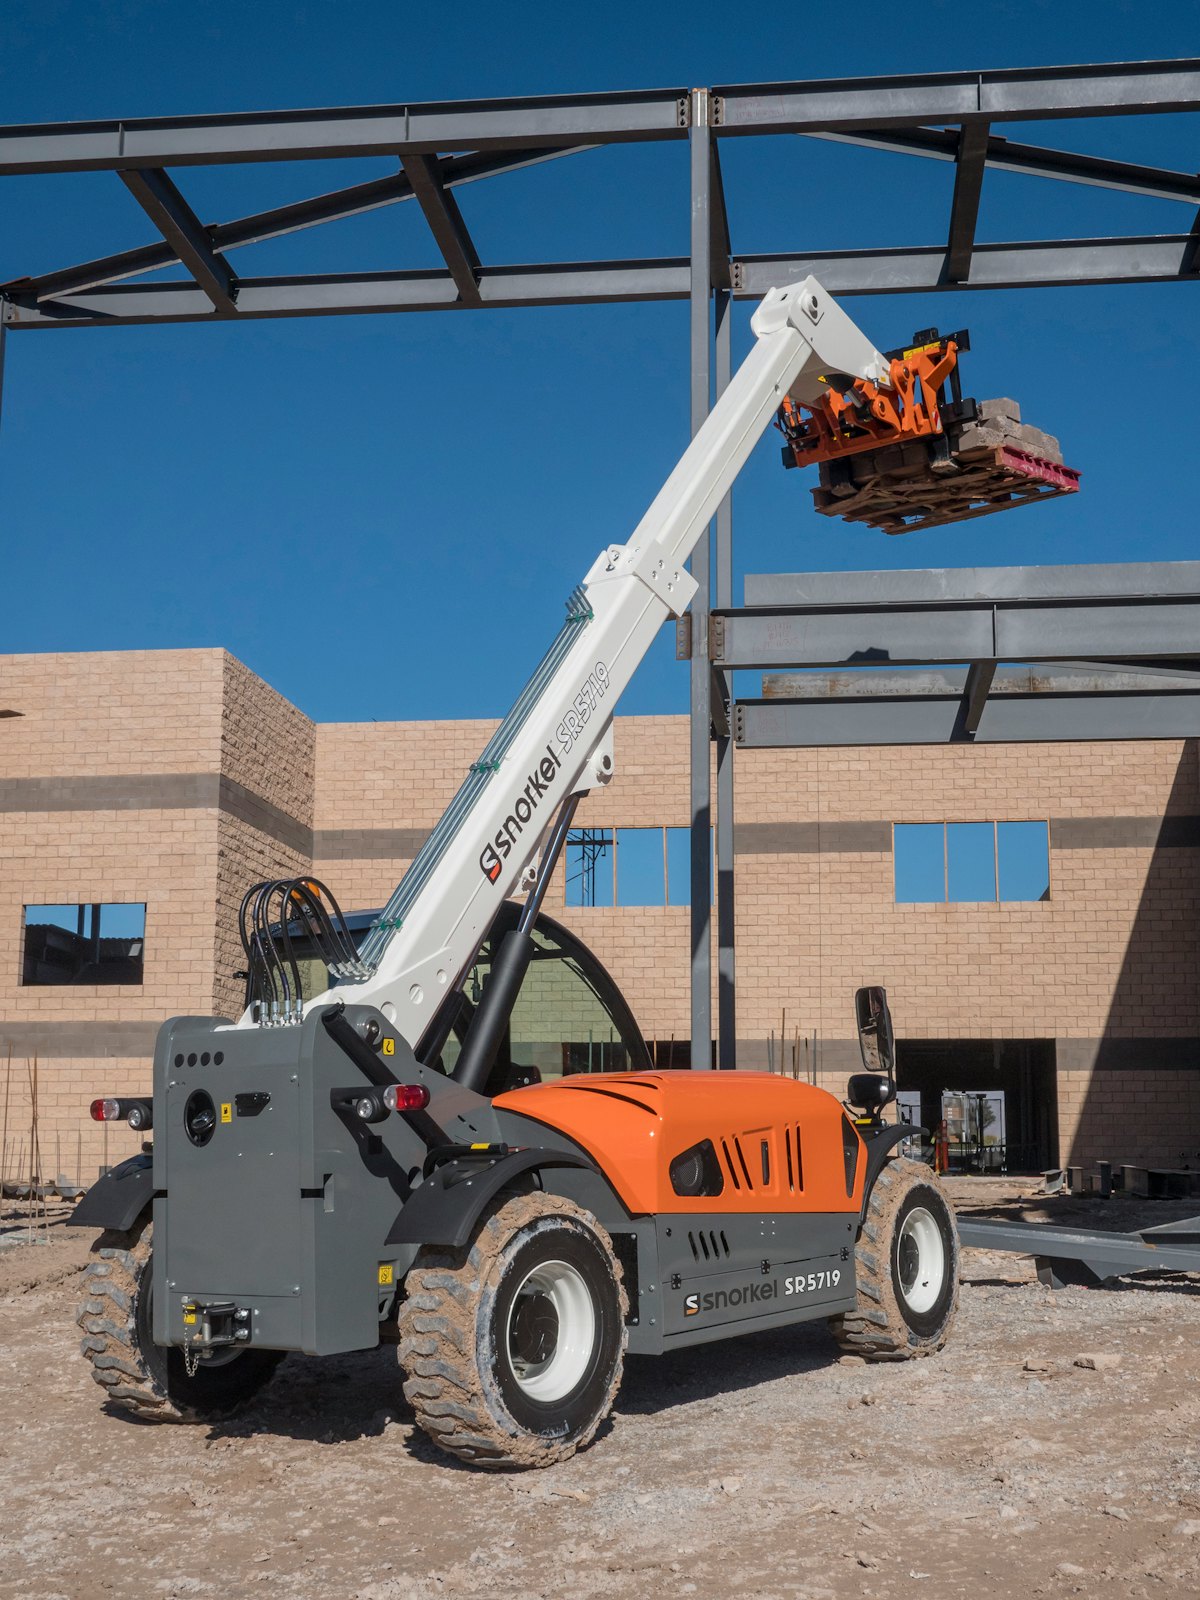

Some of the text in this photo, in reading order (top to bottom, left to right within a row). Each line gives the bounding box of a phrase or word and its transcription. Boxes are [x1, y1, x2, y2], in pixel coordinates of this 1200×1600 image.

[495, 745, 562, 858] snorkel
[556, 662, 609, 753] SR5719
[703, 1280, 778, 1311] snorkel
[784, 1269, 841, 1295] SR5719
